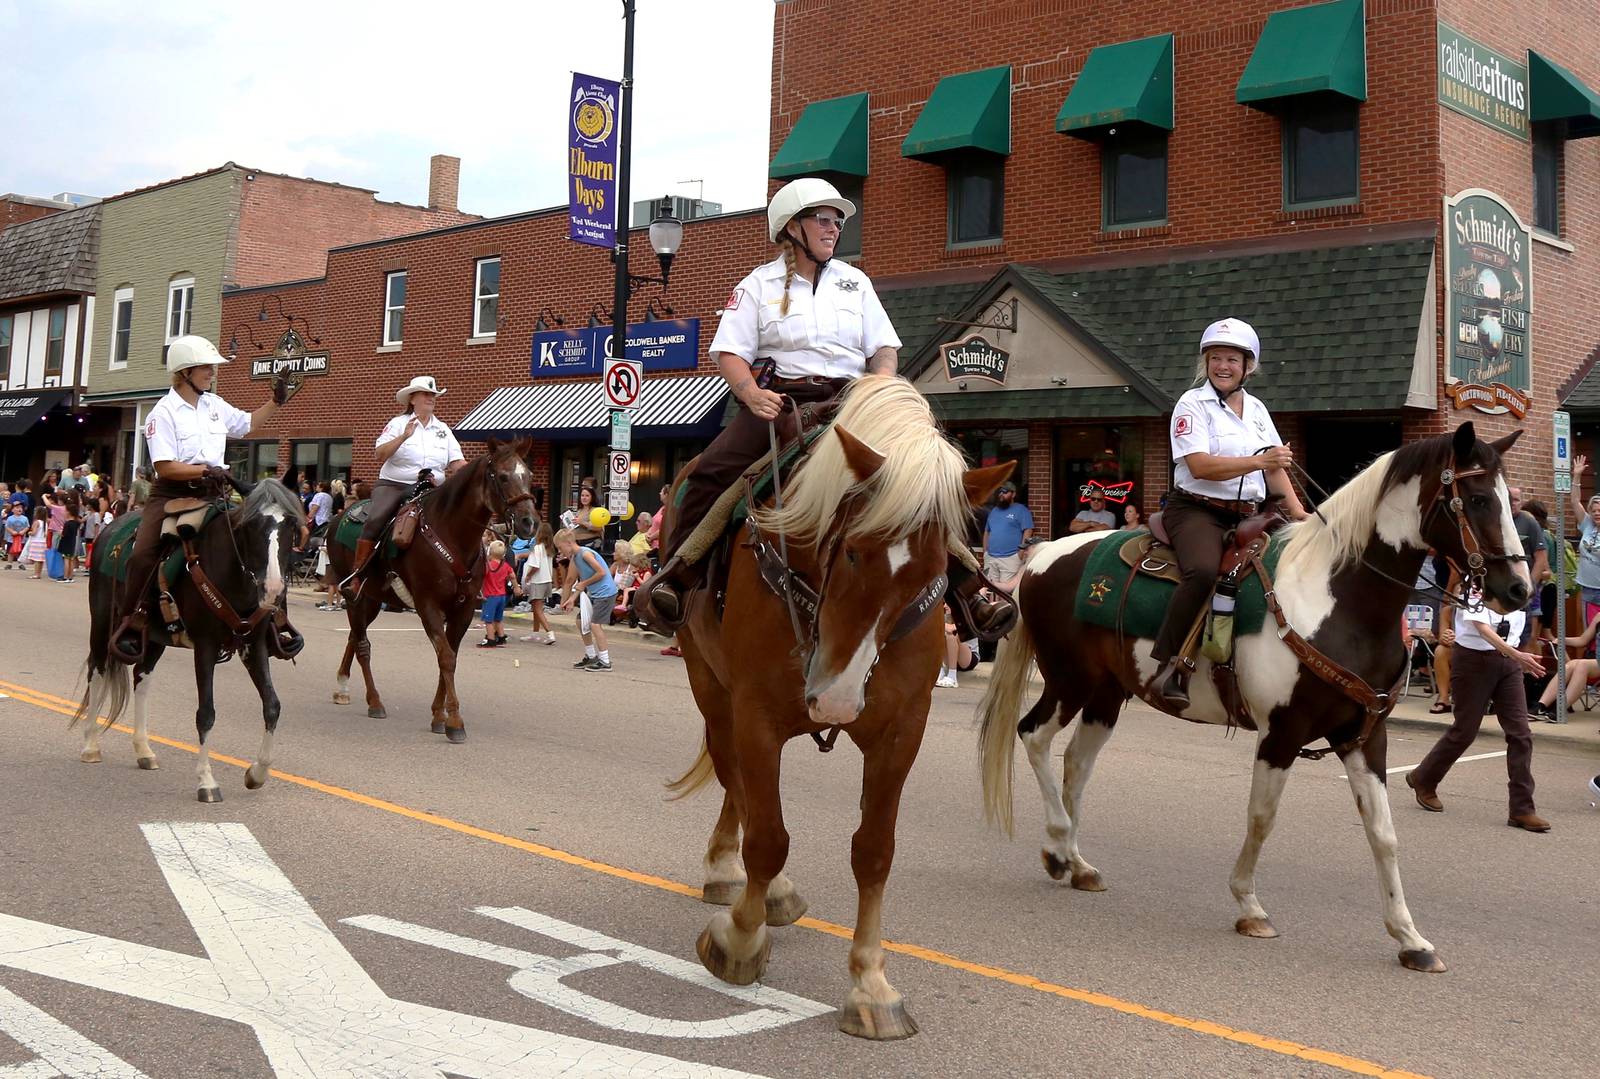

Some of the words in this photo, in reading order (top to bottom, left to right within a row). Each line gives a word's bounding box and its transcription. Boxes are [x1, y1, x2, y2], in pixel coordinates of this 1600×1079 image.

[1442, 78, 1490, 116] INSURANCE
[1494, 102, 1526, 132] AGENCY
[570, 147, 613, 181] Elburn
[575, 178, 605, 215] Days
[584, 219, 612, 230] Weekend
[584, 229, 605, 240] August
[1455, 208, 1521, 263] Schmidt's
[1501, 308, 1525, 329] FISH
[563, 339, 583, 349] KELLY
[625, 337, 658, 347] COLDWELL
[658, 334, 686, 345] BANKER
[558, 347, 587, 357] SCHMIDT
[642, 349, 666, 358] REALTY
[949, 347, 1004, 372] Schmidt's
[253, 360, 271, 375] KANE
[303, 356, 326, 371] COINS
[1080, 485, 1130, 497] Bweiser
[778, 575, 817, 615] MNTE
[918, 577, 943, 613] RANGERS
[1307, 655, 1353, 689] MOUNTED
